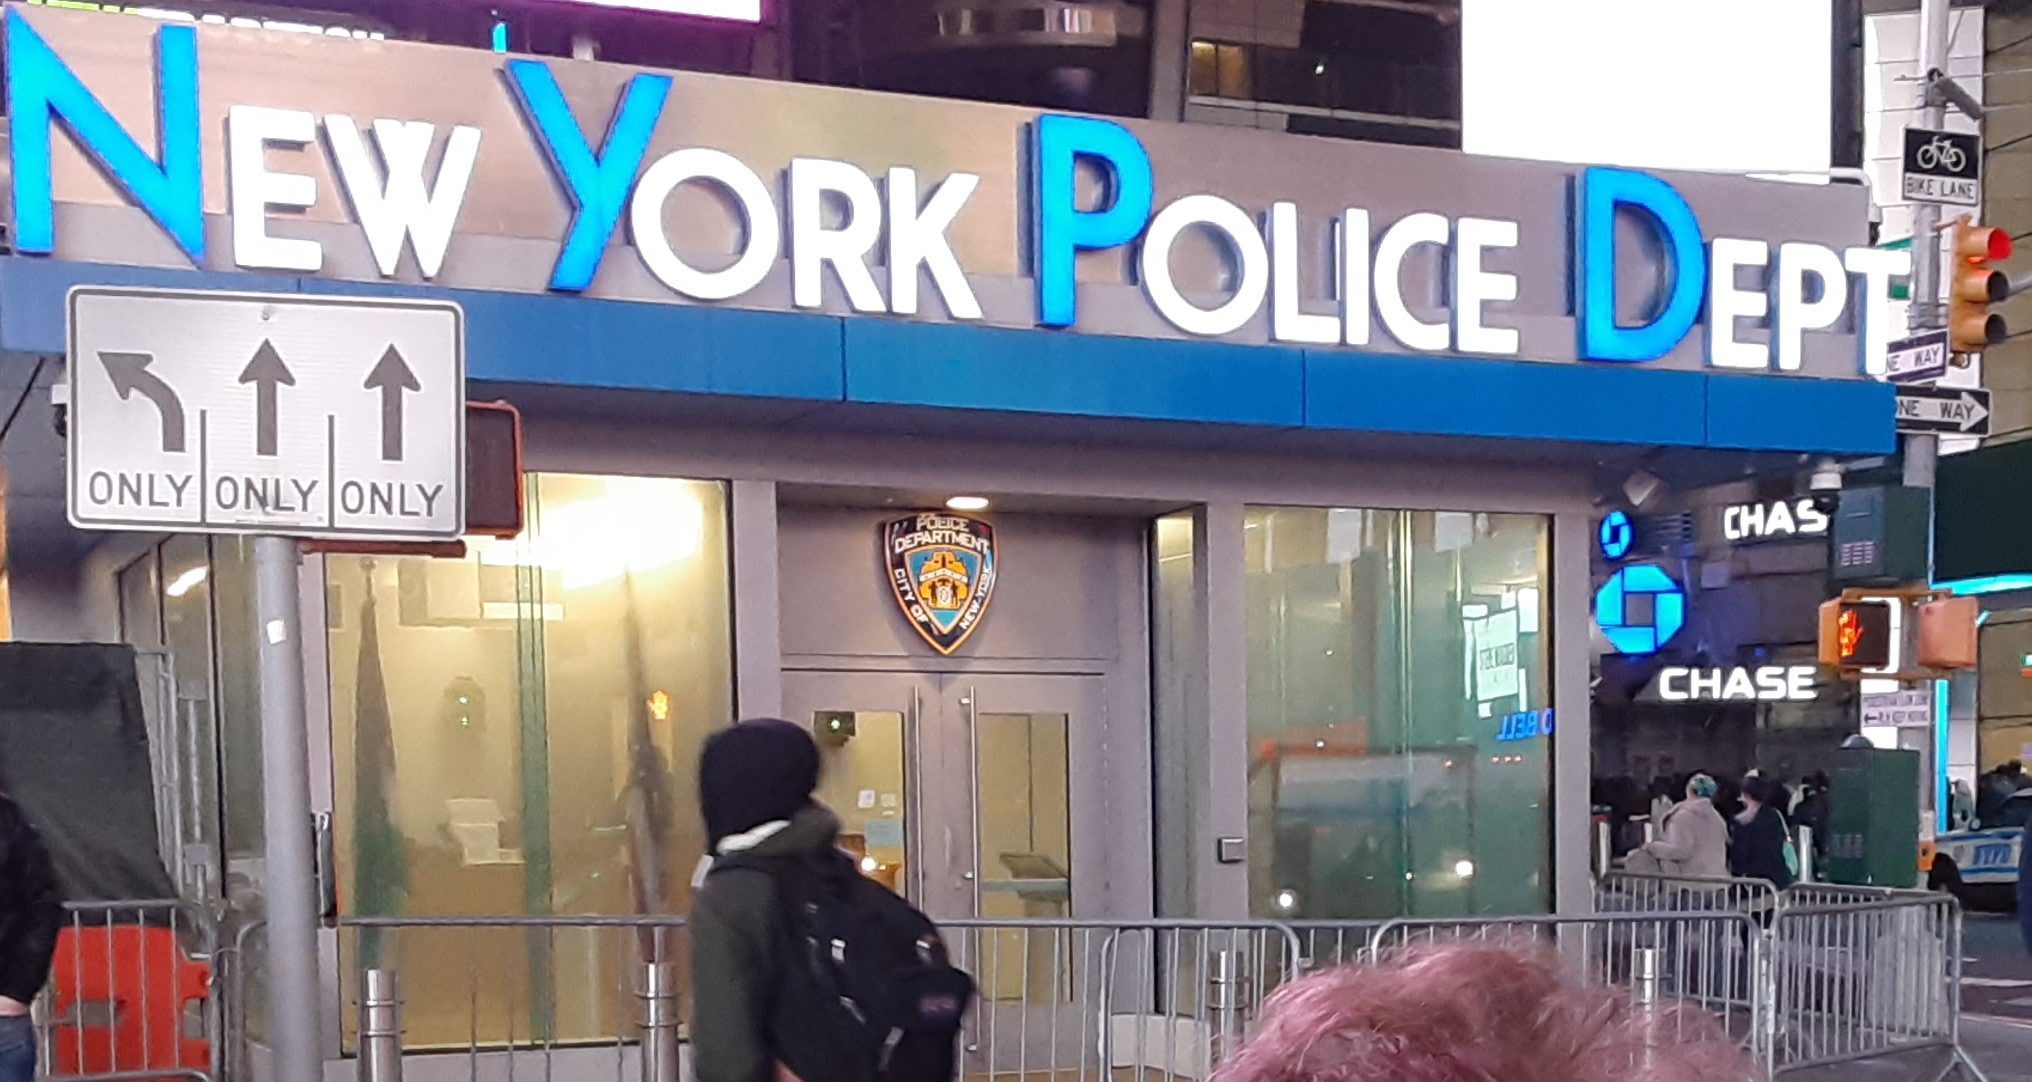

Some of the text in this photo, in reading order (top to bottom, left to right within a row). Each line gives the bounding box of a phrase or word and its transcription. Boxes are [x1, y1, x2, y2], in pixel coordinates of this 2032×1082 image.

[4, 3, 1913, 376] NEW YORK POLICE DEPT
[1906, 176, 1975, 200] BIKE LANE
[1914, 346, 1940, 367] WAY
[1898, 399, 1975, 419] NE WAY
[88, 470, 444, 518] ONLY ONLY ONLY
[916, 517, 970, 532] POLICE
[894, 530, 990, 553] DEPARTMENT
[894, 567, 930, 624] CITY OF
[958, 600, 981, 630] NEW
[1659, 666, 1818, 700] CHASE
